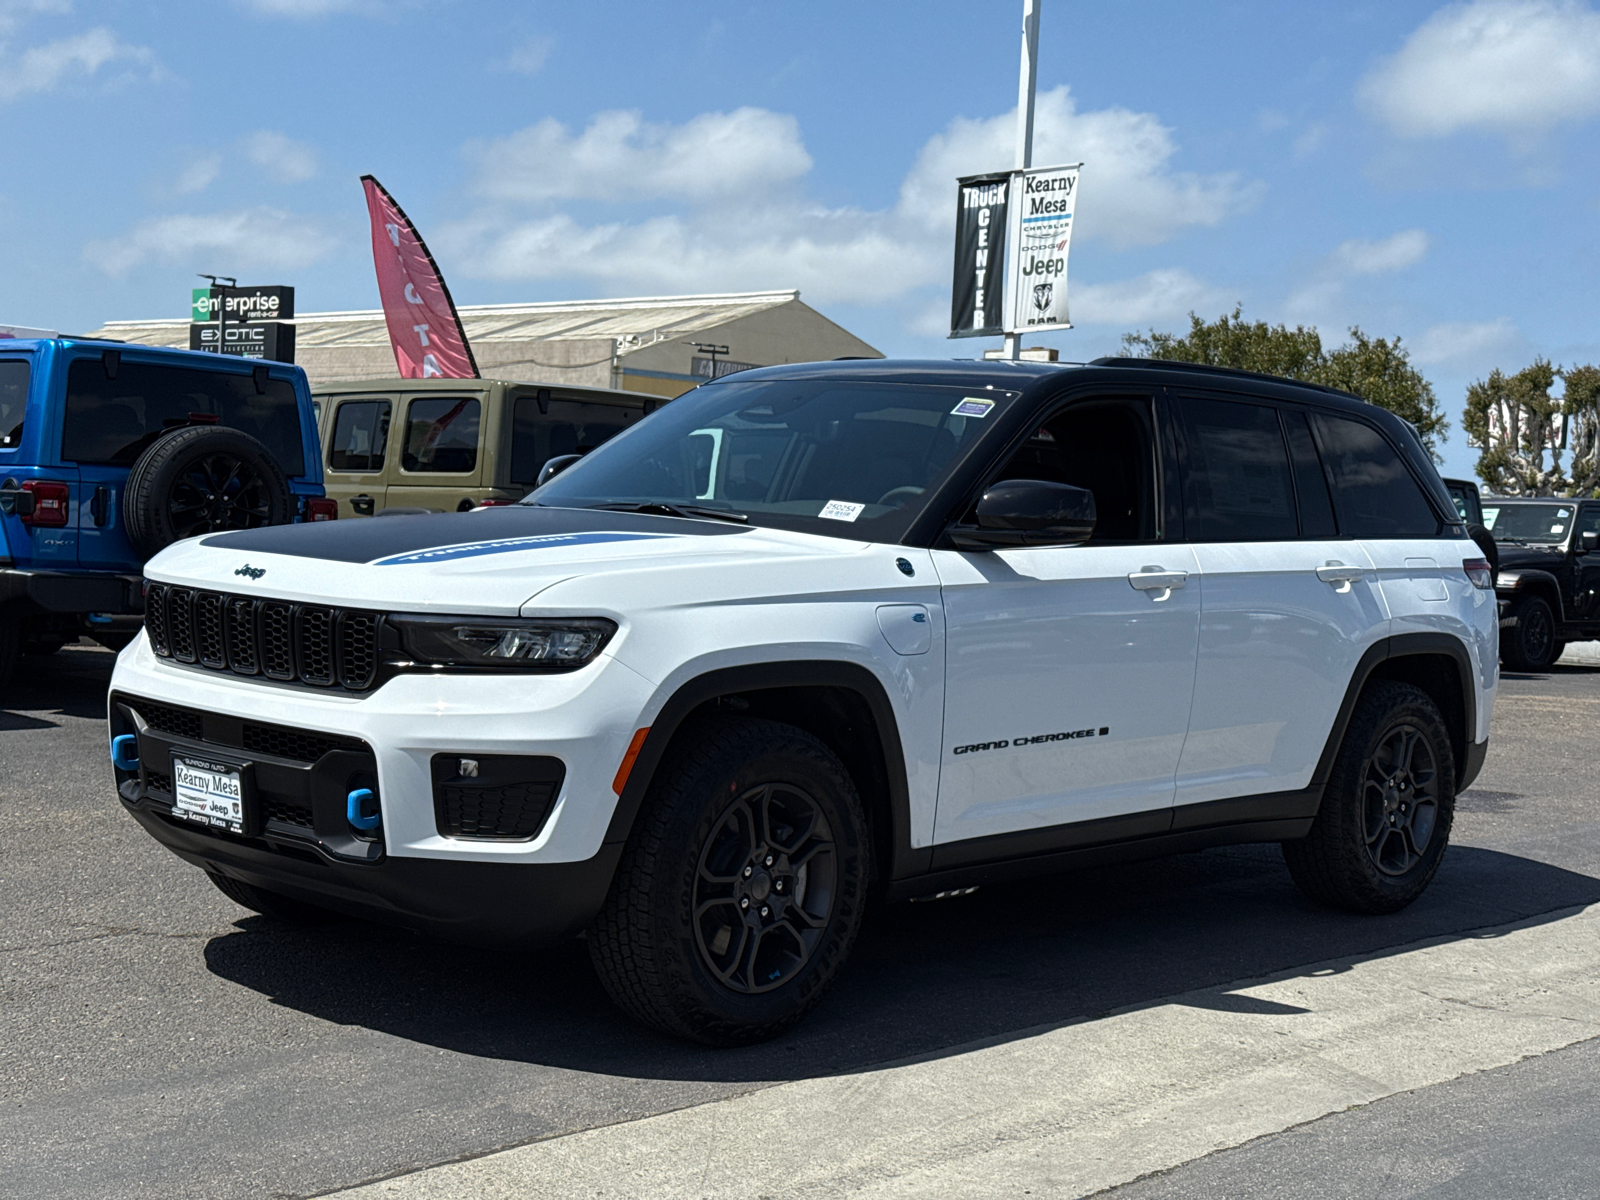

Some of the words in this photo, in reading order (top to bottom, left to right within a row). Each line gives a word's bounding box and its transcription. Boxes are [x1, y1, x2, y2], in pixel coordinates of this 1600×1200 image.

[1025, 175, 1076, 196] Kearny
[963, 183, 1007, 208] TRUCK
[1030, 197, 1067, 215] Mesa
[1023, 222, 1069, 232] CHRYSLER
[973, 208, 990, 329] CENTER
[1023, 255, 1064, 278] Jeep
[193, 291, 279, 316] enterprise
[1028, 316, 1057, 326] RAM
[201, 328, 265, 341] EXOTIC
[234, 563, 267, 581] Jeep
[953, 740, 1009, 755] GRAND
[1013, 729, 1095, 746] CHEROKEE
[177, 767, 210, 794] Kearny
[212, 775, 239, 796] Mesa
[209, 801, 229, 817] Jeep
[188, 811, 210, 826] Kearny
[210, 816, 226, 828] Mesa
